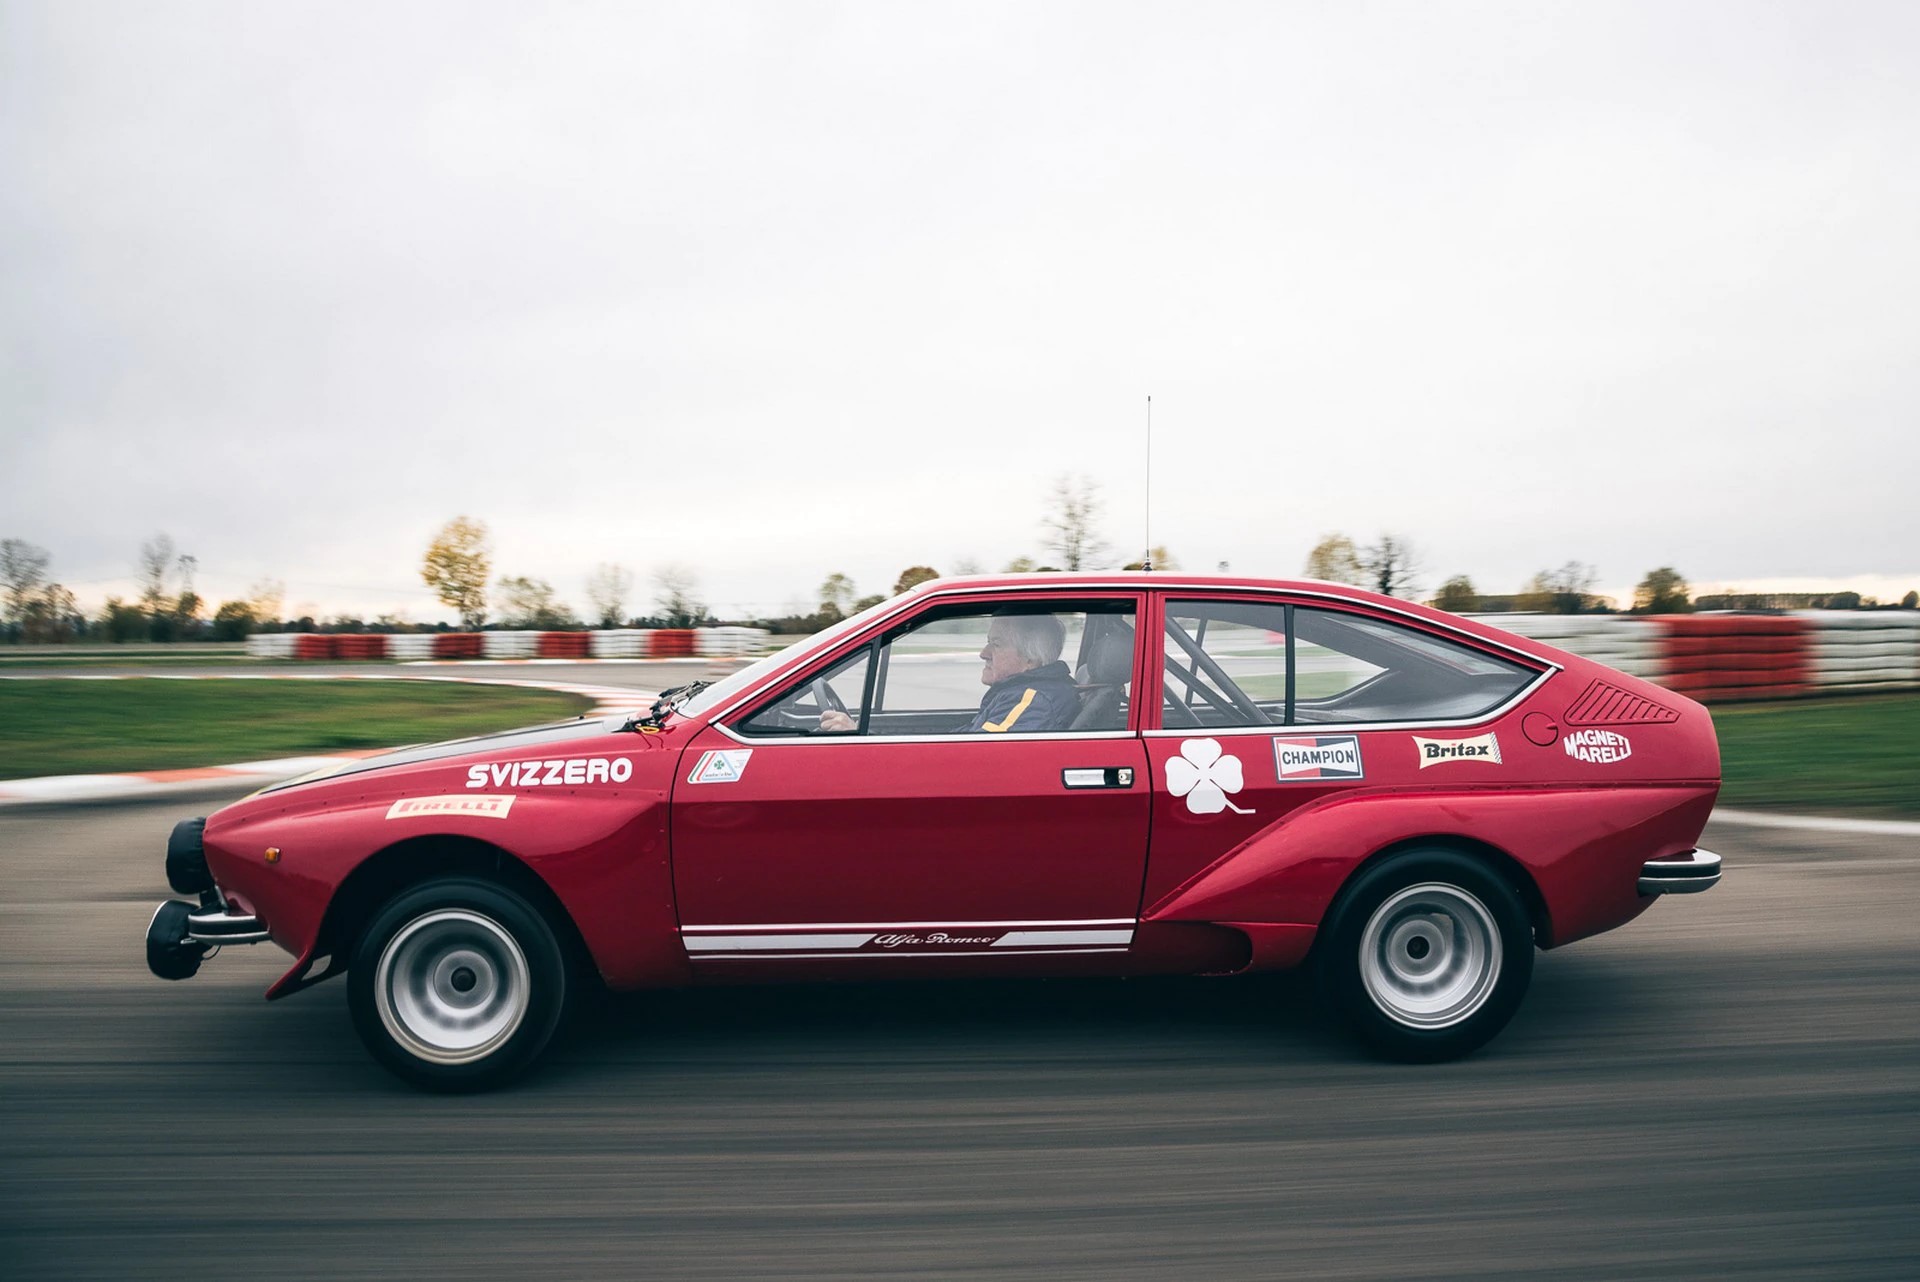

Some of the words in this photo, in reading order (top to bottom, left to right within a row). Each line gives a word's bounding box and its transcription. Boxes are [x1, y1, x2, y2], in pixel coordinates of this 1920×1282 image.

[1563, 729, 1632, 755] MAGNETI
[1282, 750, 1355, 765] CHAMPION
[1424, 743, 1489, 758] Britax
[1563, 740, 1632, 763] MARELLI
[465, 757, 633, 788] SVIZZERO
[398, 798, 504, 813] PIRELLI
[874, 933, 924, 948] Alfa
[925, 932, 995, 944] Romeo
